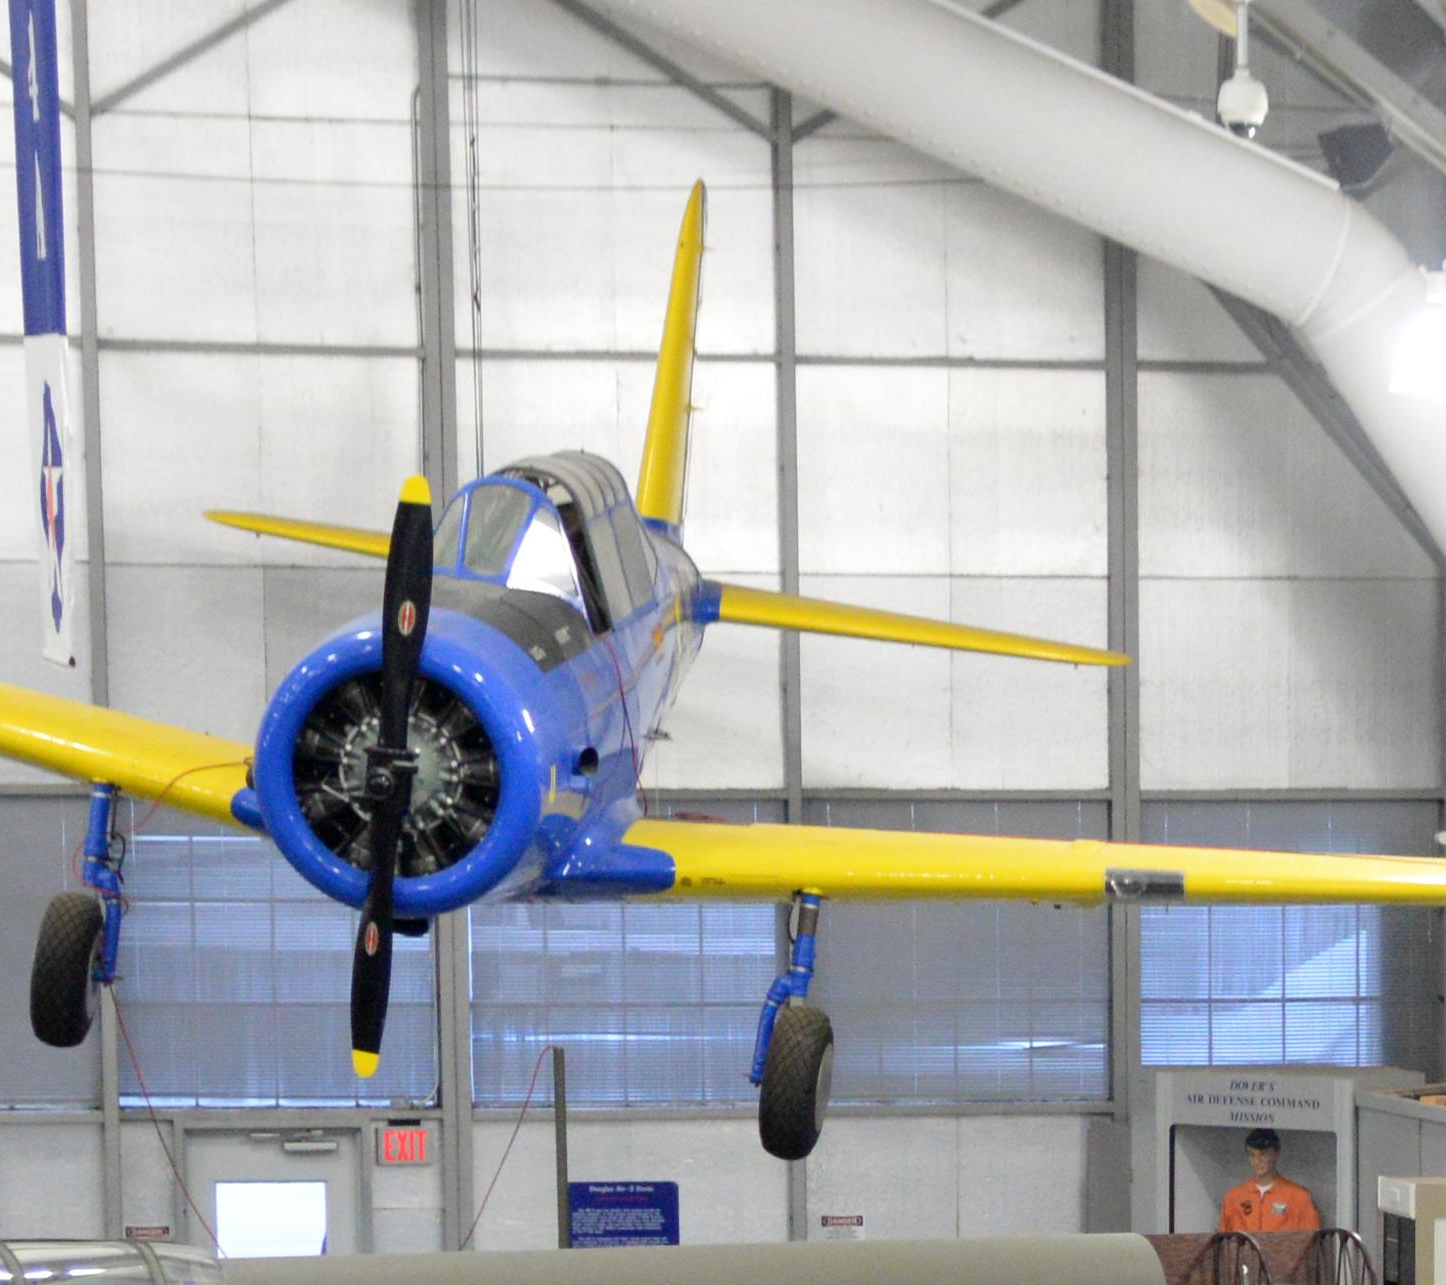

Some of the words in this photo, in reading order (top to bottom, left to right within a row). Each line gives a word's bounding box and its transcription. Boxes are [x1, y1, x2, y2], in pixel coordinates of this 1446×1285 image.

[1230, 1080, 1276, 1092] DOVER'S
[1186, 1094, 1204, 1104] AIR
[1208, 1095, 1254, 1107] DEFENSE
[1260, 1098, 1320, 1110] COMMAND
[1229, 1111, 1275, 1123] MISSION
[383, 1130, 427, 1161] EXIT
